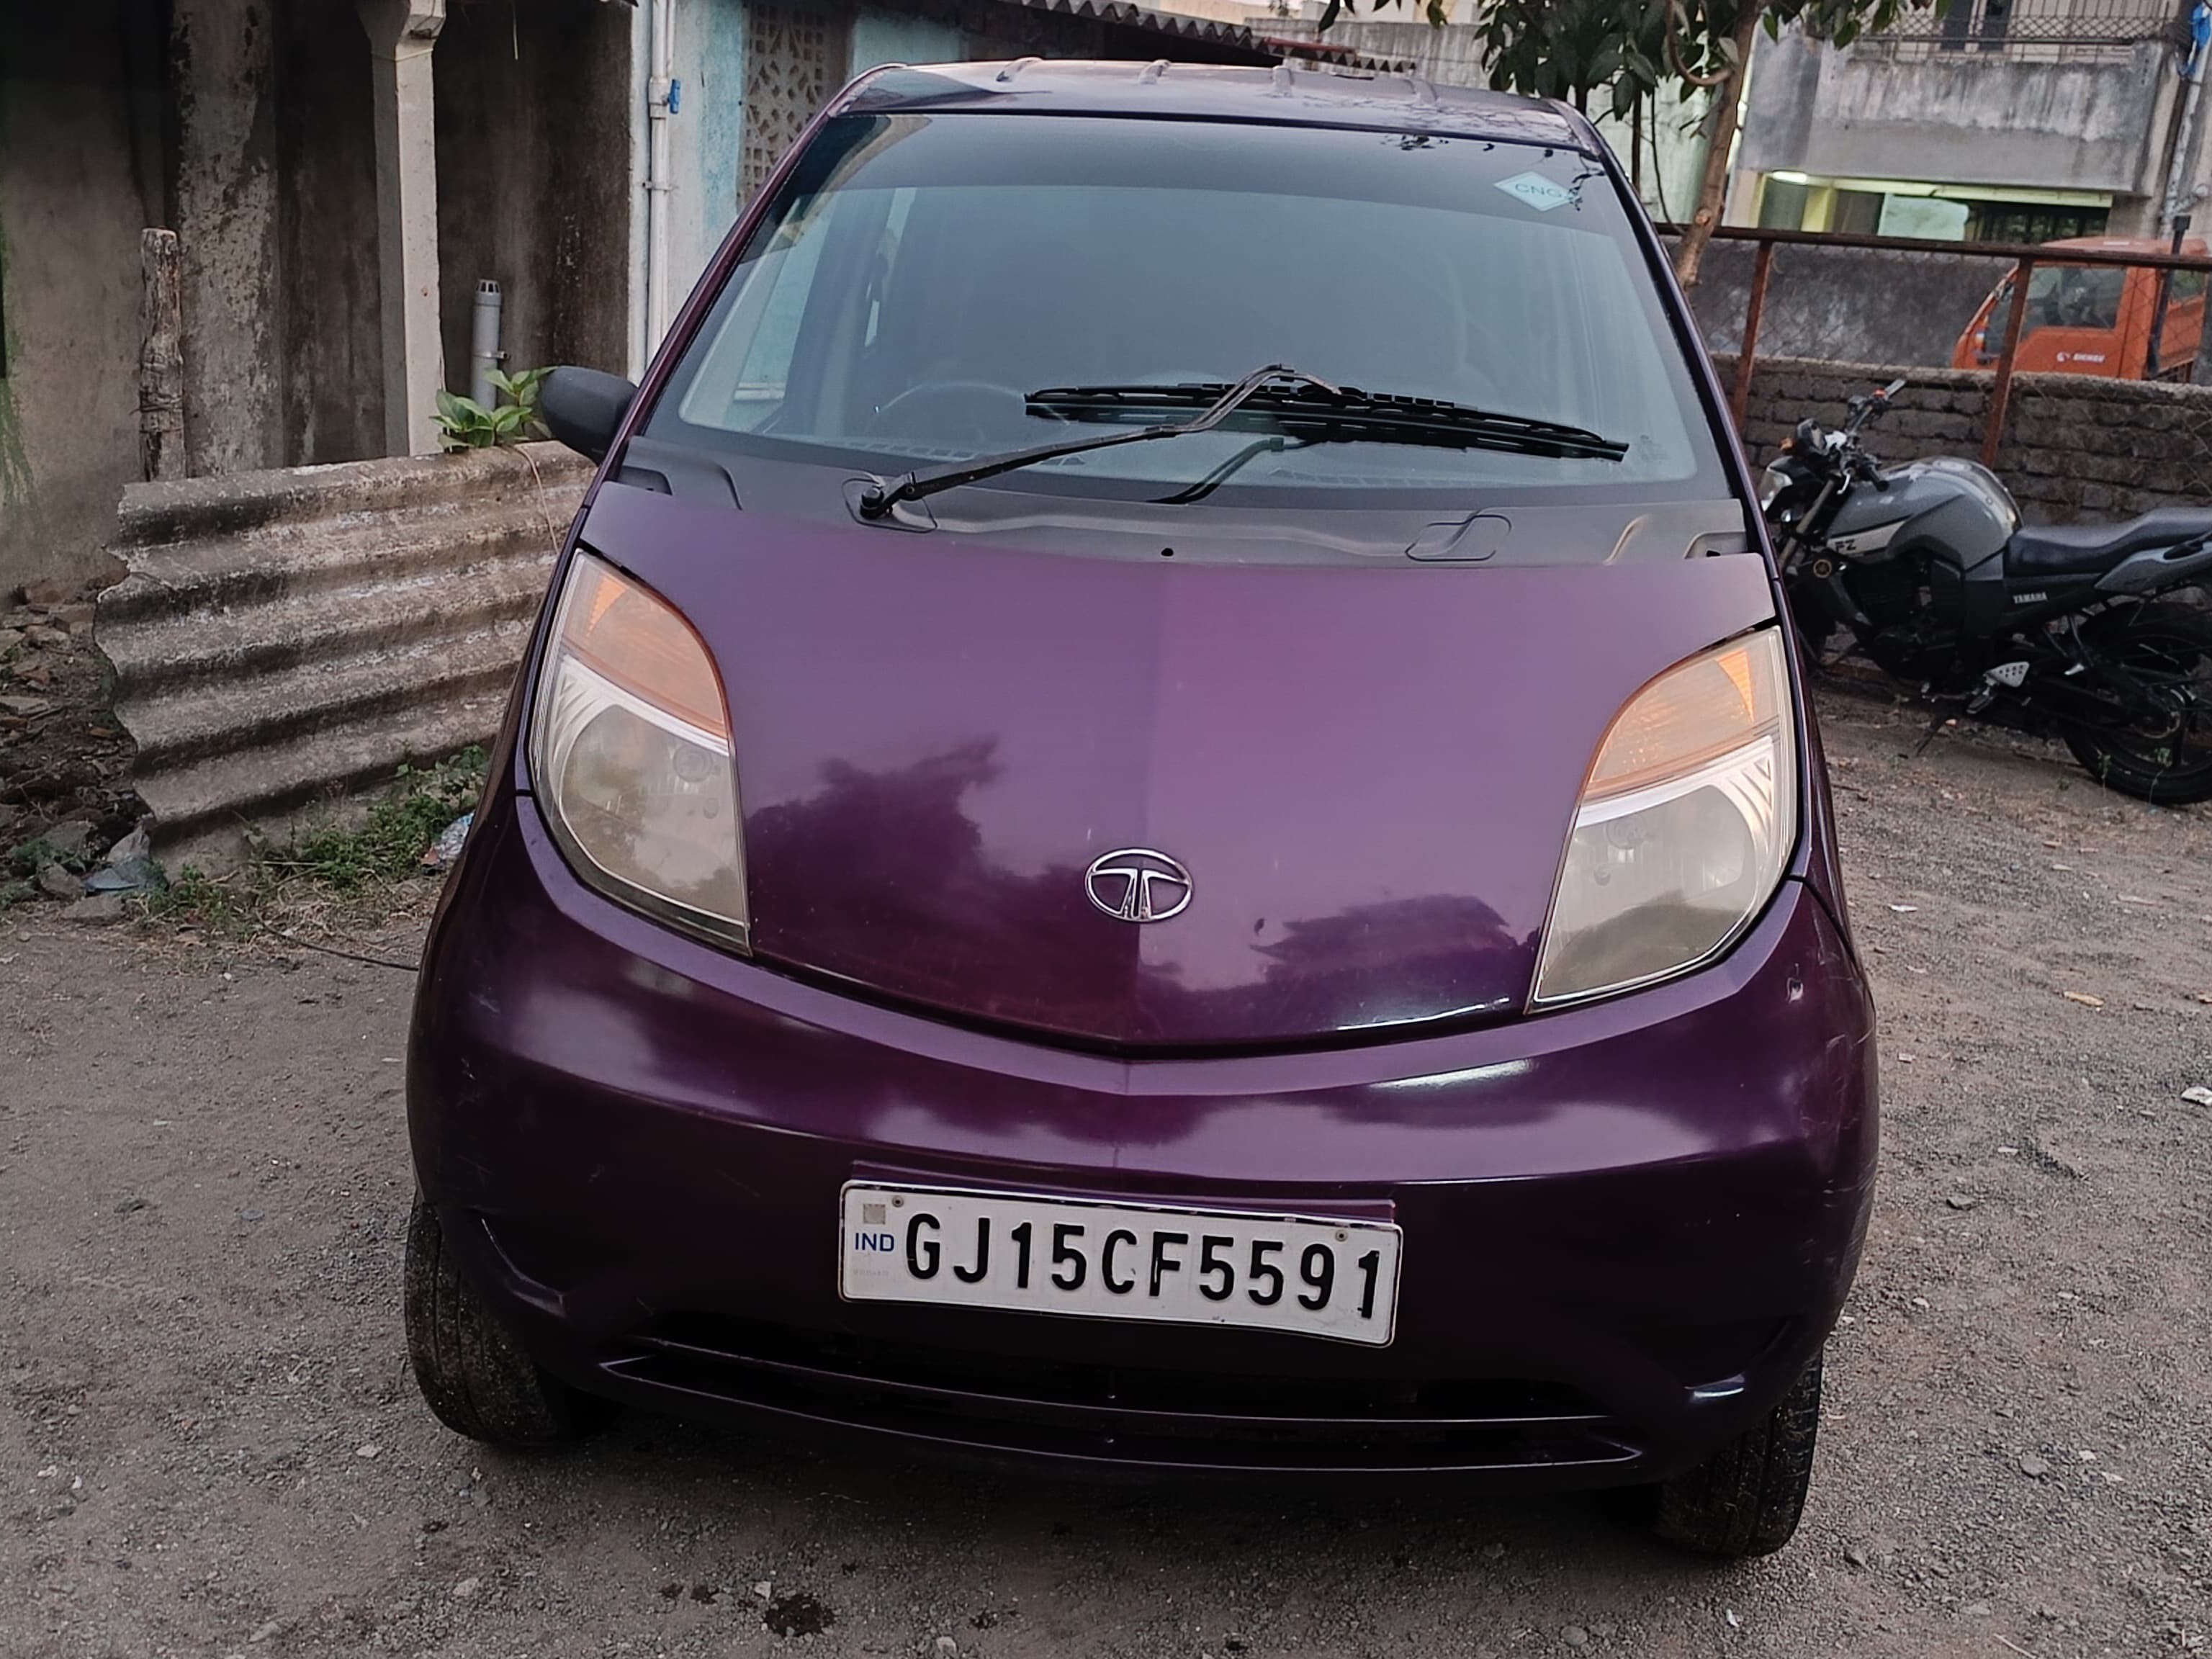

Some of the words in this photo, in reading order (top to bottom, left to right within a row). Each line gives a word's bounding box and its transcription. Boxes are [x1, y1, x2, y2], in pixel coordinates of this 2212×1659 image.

[1515, 184, 1562, 198] CNG
[855, 1232, 894, 1251] IND
[905, 1213, 1380, 1319] GJ15CF5591
